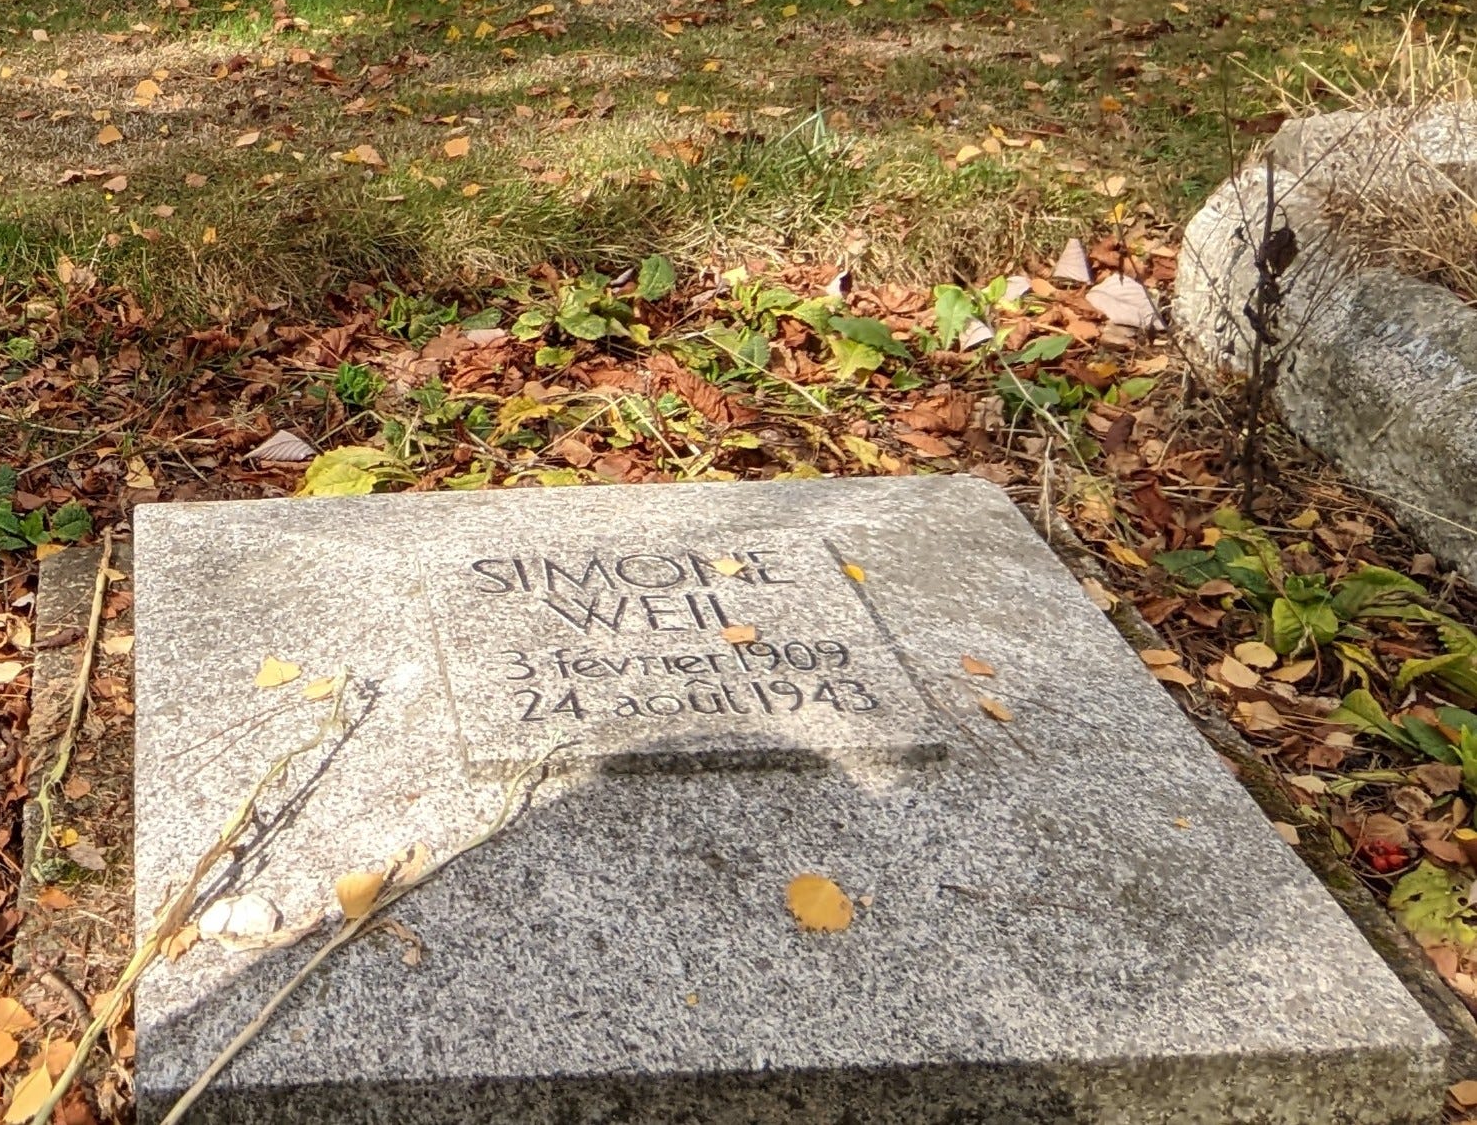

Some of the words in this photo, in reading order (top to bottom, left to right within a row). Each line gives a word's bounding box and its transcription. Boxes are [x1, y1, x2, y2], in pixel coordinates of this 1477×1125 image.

[471, 550, 796, 595] SIMONE
[501, 649, 537, 681] 3
[553, 647, 730, 679] février
[734, 639, 851, 673] 1909
[513, 688, 585, 722] 24
[614, 679, 750, 718] août
[751, 678, 879, 715] 1943
